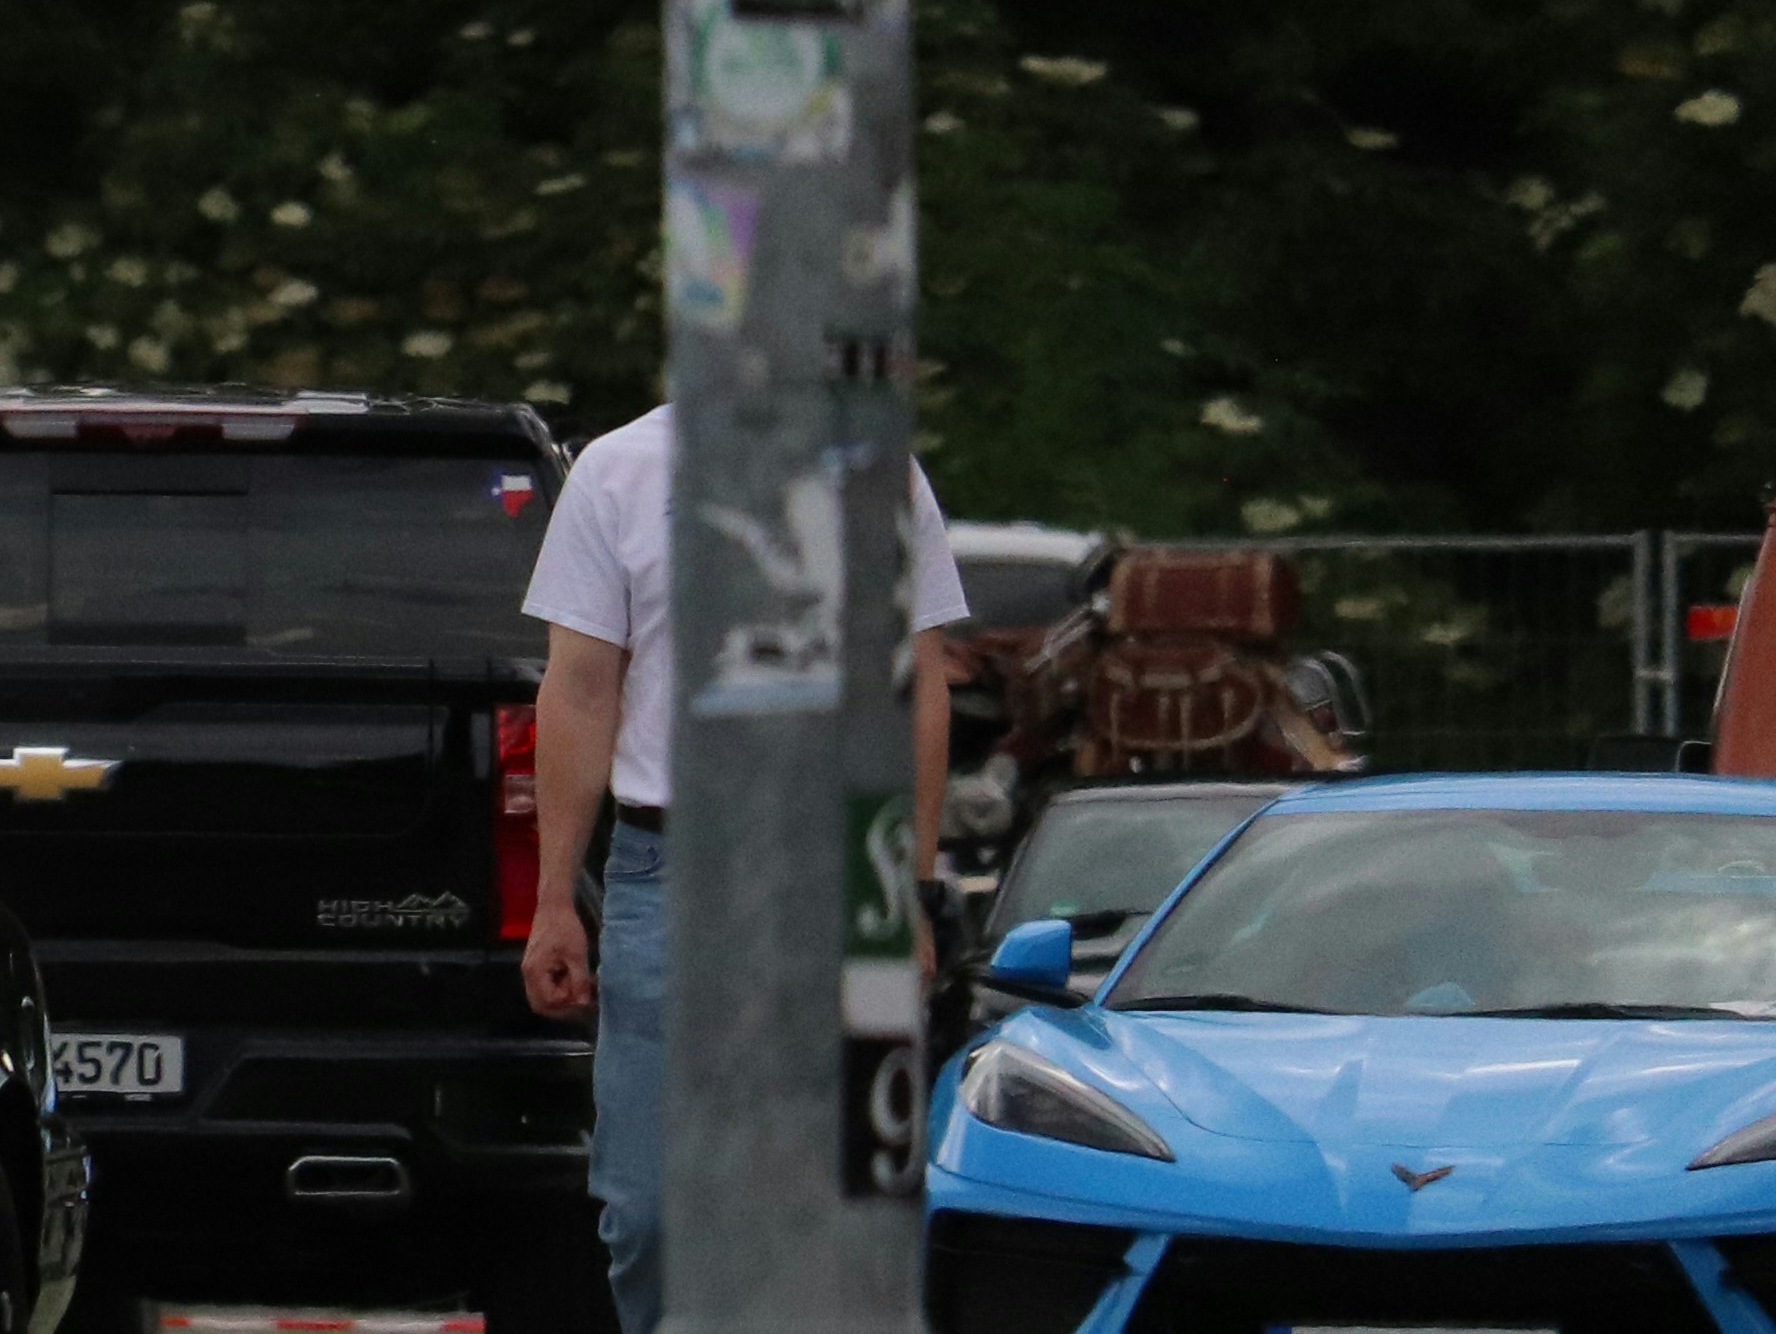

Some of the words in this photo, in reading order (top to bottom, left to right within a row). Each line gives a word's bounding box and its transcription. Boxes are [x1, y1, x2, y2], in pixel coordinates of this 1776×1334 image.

[318, 899, 394, 913] HIGH
[317, 913, 470, 929] COUNTRY
[53, 1040, 163, 1086] 4570
